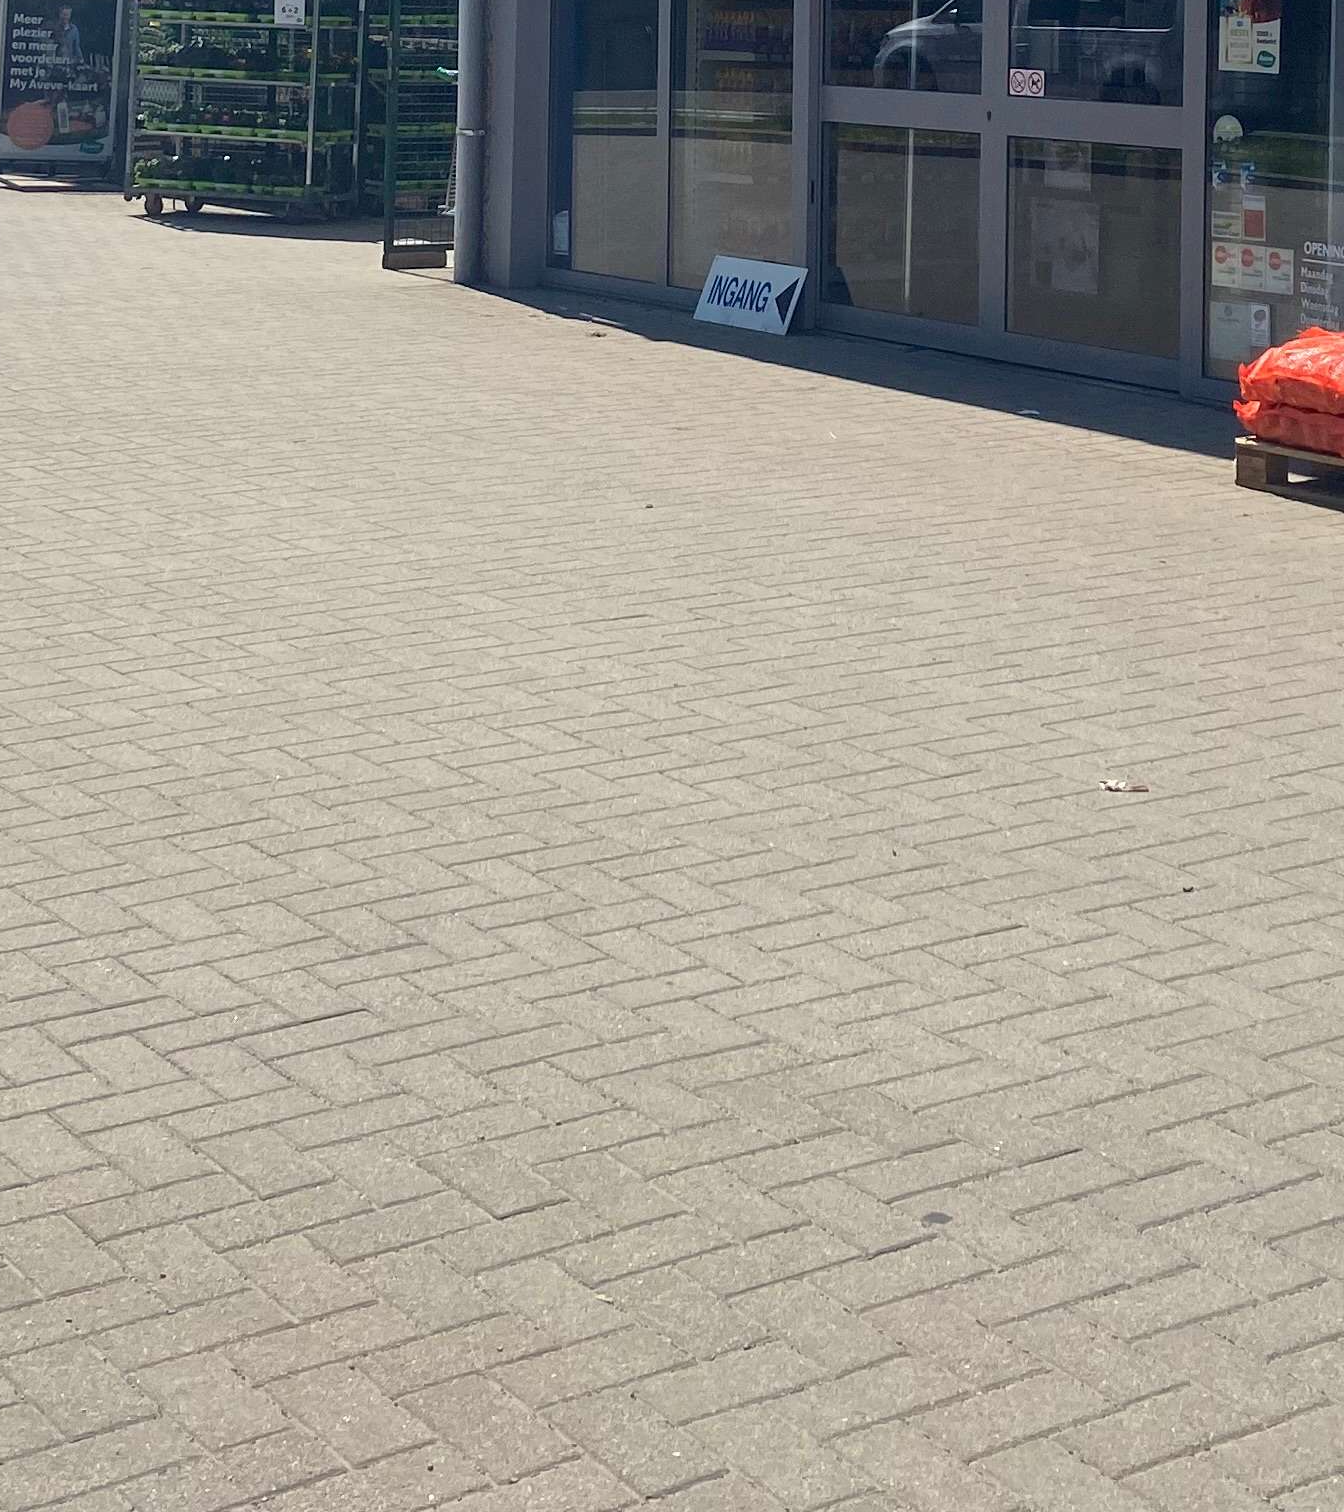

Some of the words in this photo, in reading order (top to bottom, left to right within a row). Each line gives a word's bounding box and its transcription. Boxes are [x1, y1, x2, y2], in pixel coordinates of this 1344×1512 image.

[13, 13, 44, 25] Meer
[12, 27, 54, 39] plezier
[11, 42, 26, 51] en
[28, 42, 59, 51] meer
[10, 66, 33, 77] met
[34, 67, 46, 79] je
[9, 78, 29, 92] My
[706, 275, 772, 313] INGANG
